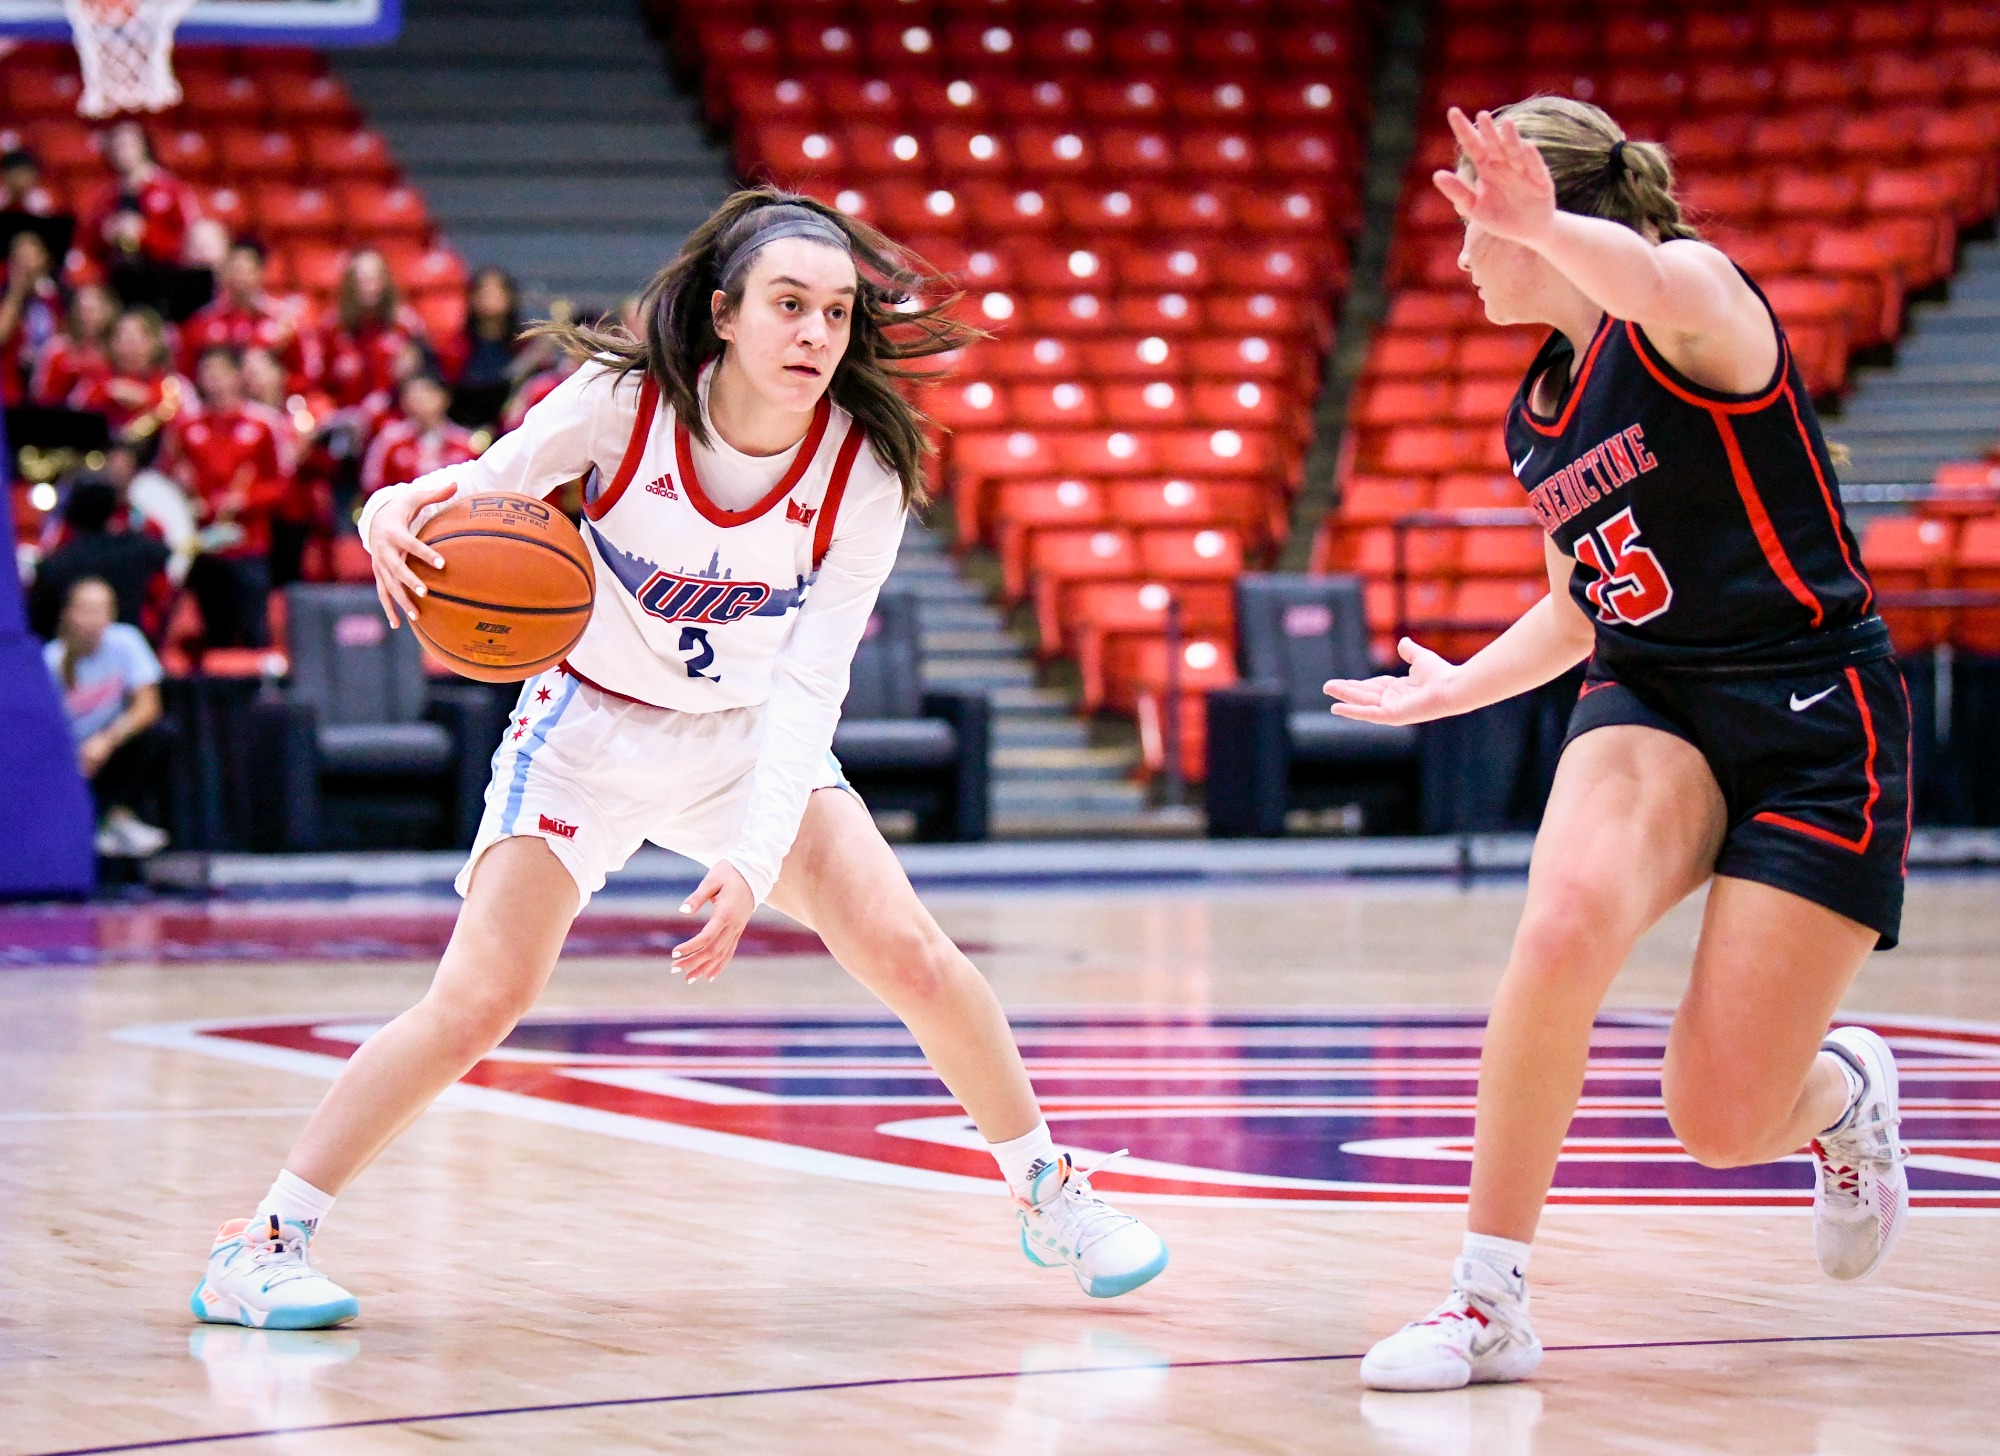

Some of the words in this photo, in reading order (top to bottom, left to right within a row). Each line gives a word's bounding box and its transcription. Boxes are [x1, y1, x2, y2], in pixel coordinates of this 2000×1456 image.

[645, 484, 679, 501] adidas
[1528, 422, 1659, 535] ENEDICTINE
[469, 512, 504, 520] OFFICIAL
[505, 513, 528, 522] GAME
[529, 519, 548, 531] BALL
[471, 497, 550, 521] PRO
[637, 571, 771, 624] UIC
[678, 626, 722, 683] 2
